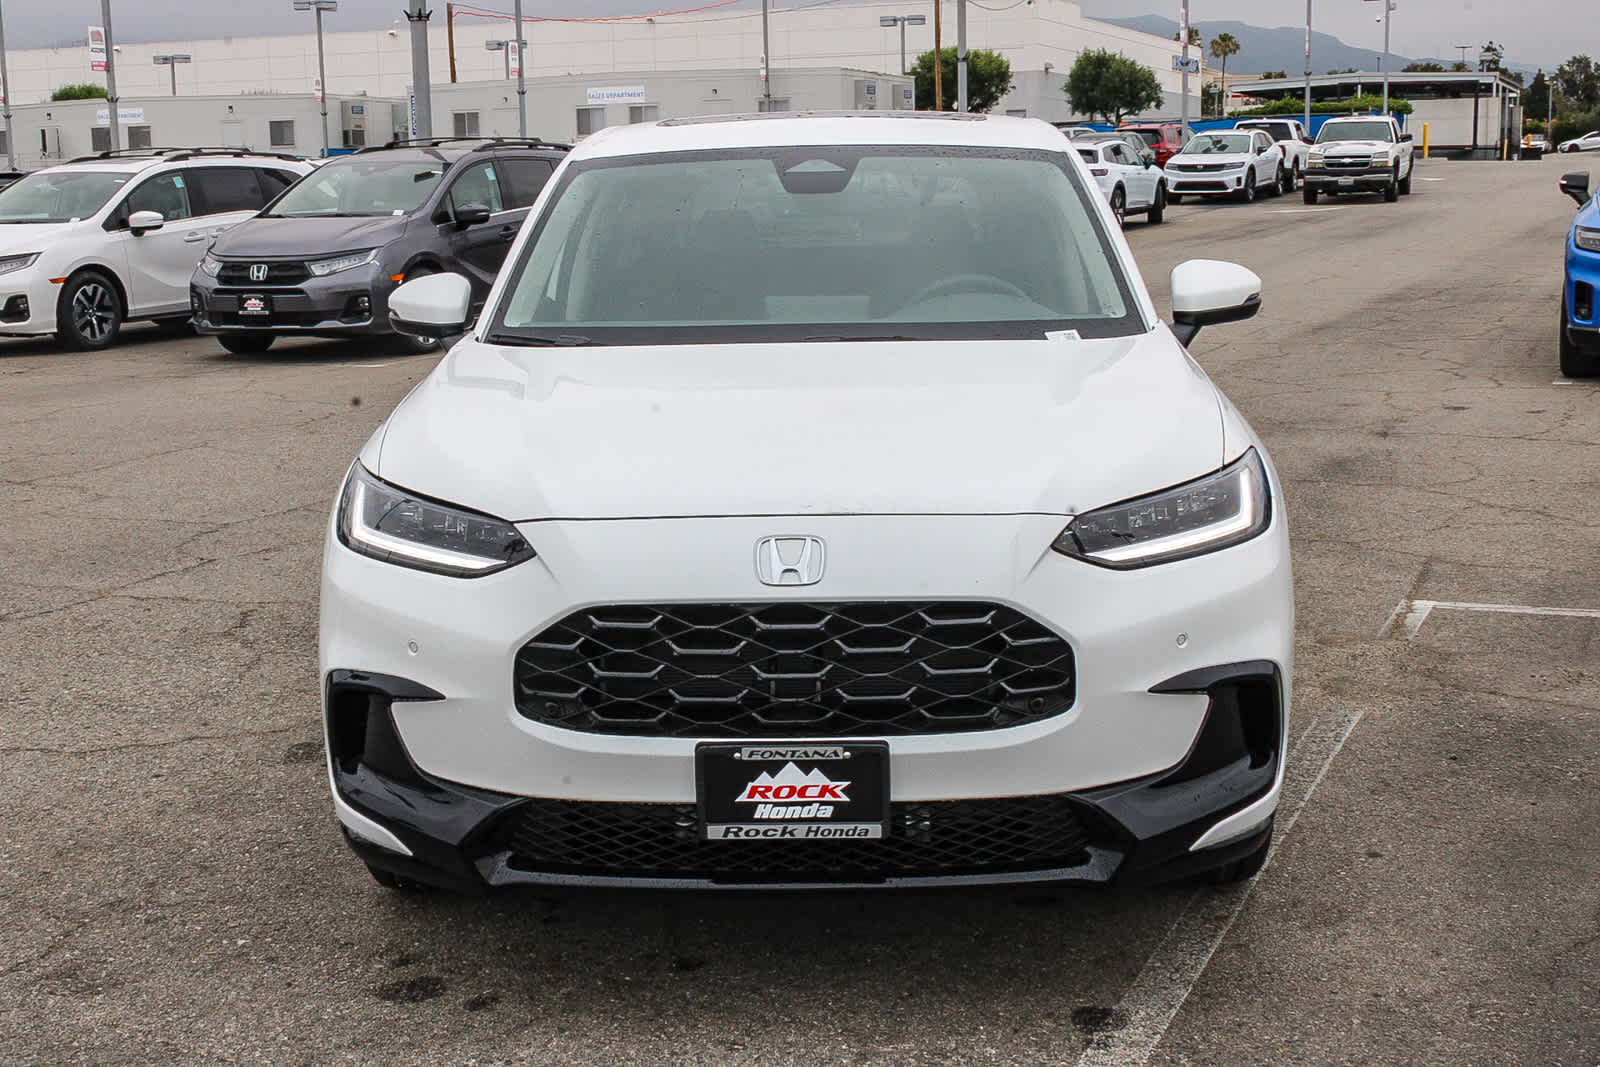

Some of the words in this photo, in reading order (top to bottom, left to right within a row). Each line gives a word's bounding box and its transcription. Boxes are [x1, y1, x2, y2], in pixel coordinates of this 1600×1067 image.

[748, 750, 841, 759] FONTANA
[747, 784, 842, 799] ROCK
[753, 803, 834, 819] Honda
[721, 826, 801, 838] Rock
[805, 825, 870, 837] Honda
